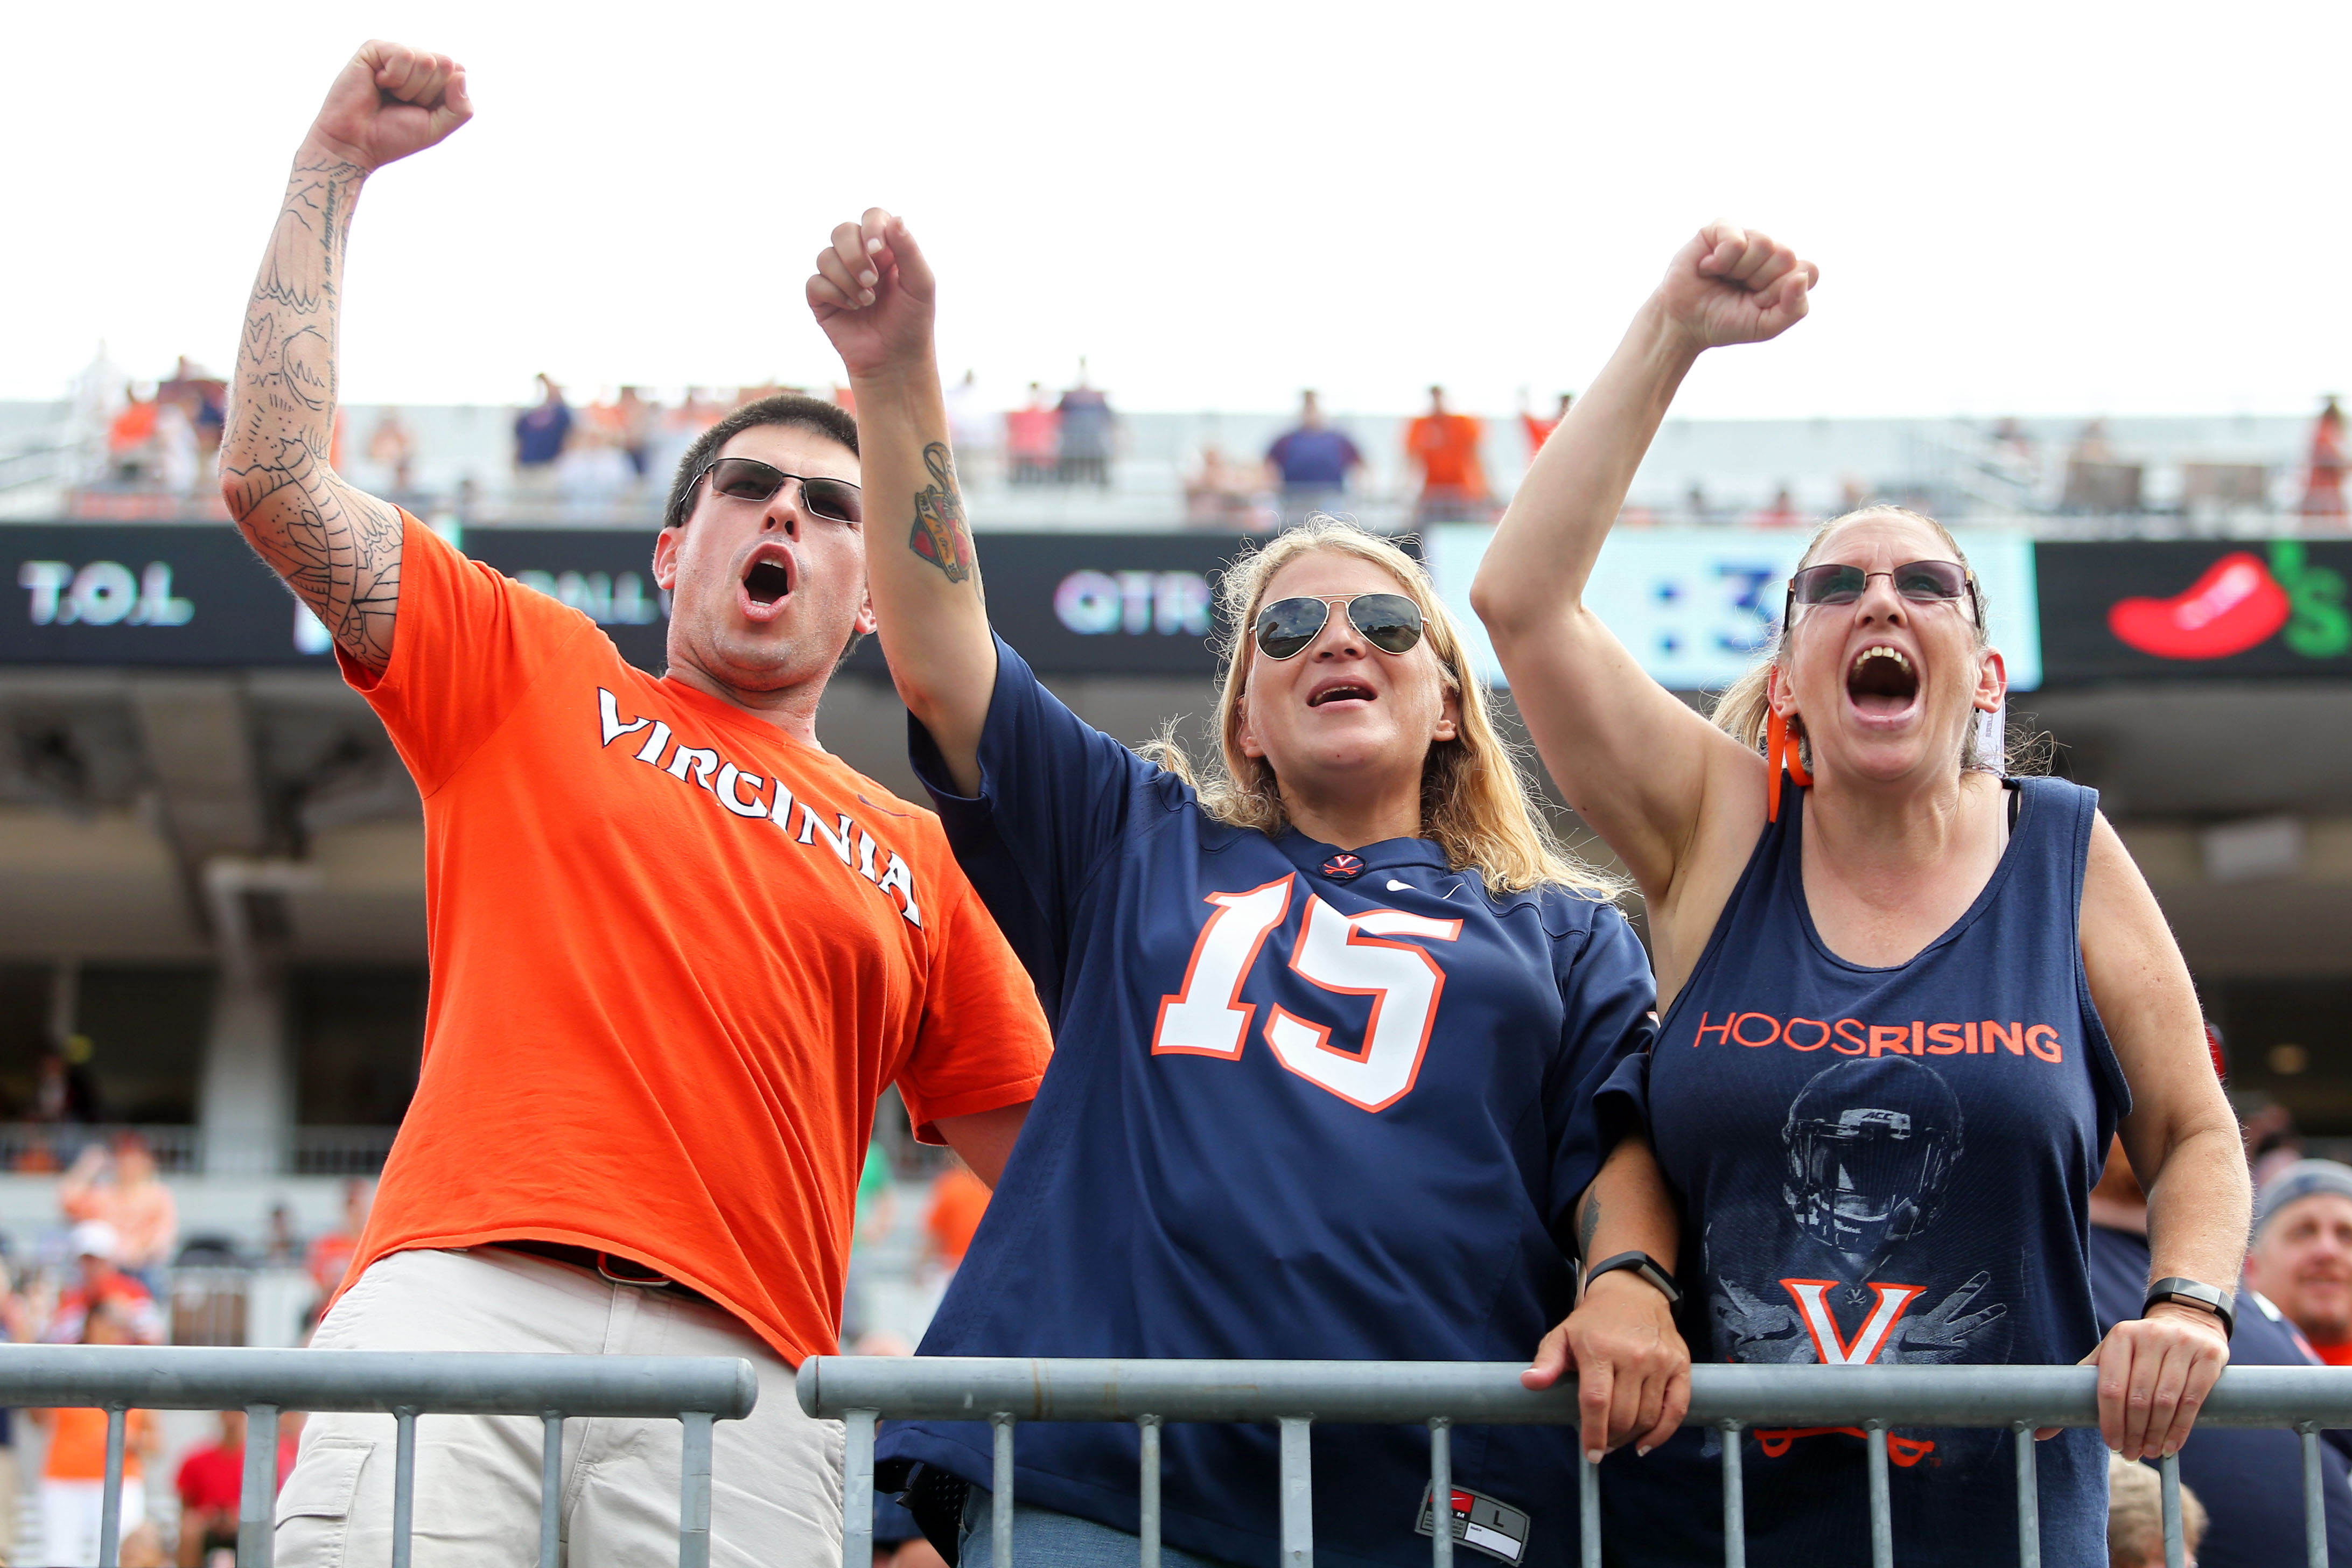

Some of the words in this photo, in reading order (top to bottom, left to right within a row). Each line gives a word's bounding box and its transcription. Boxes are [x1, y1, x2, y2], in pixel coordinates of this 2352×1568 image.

[597, 686, 923, 932] VIRGINIA
[1151, 871, 1464, 1114] 15
[1861, 1111, 1894, 1121] ACC
[1493, 1509, 1504, 1528] L
